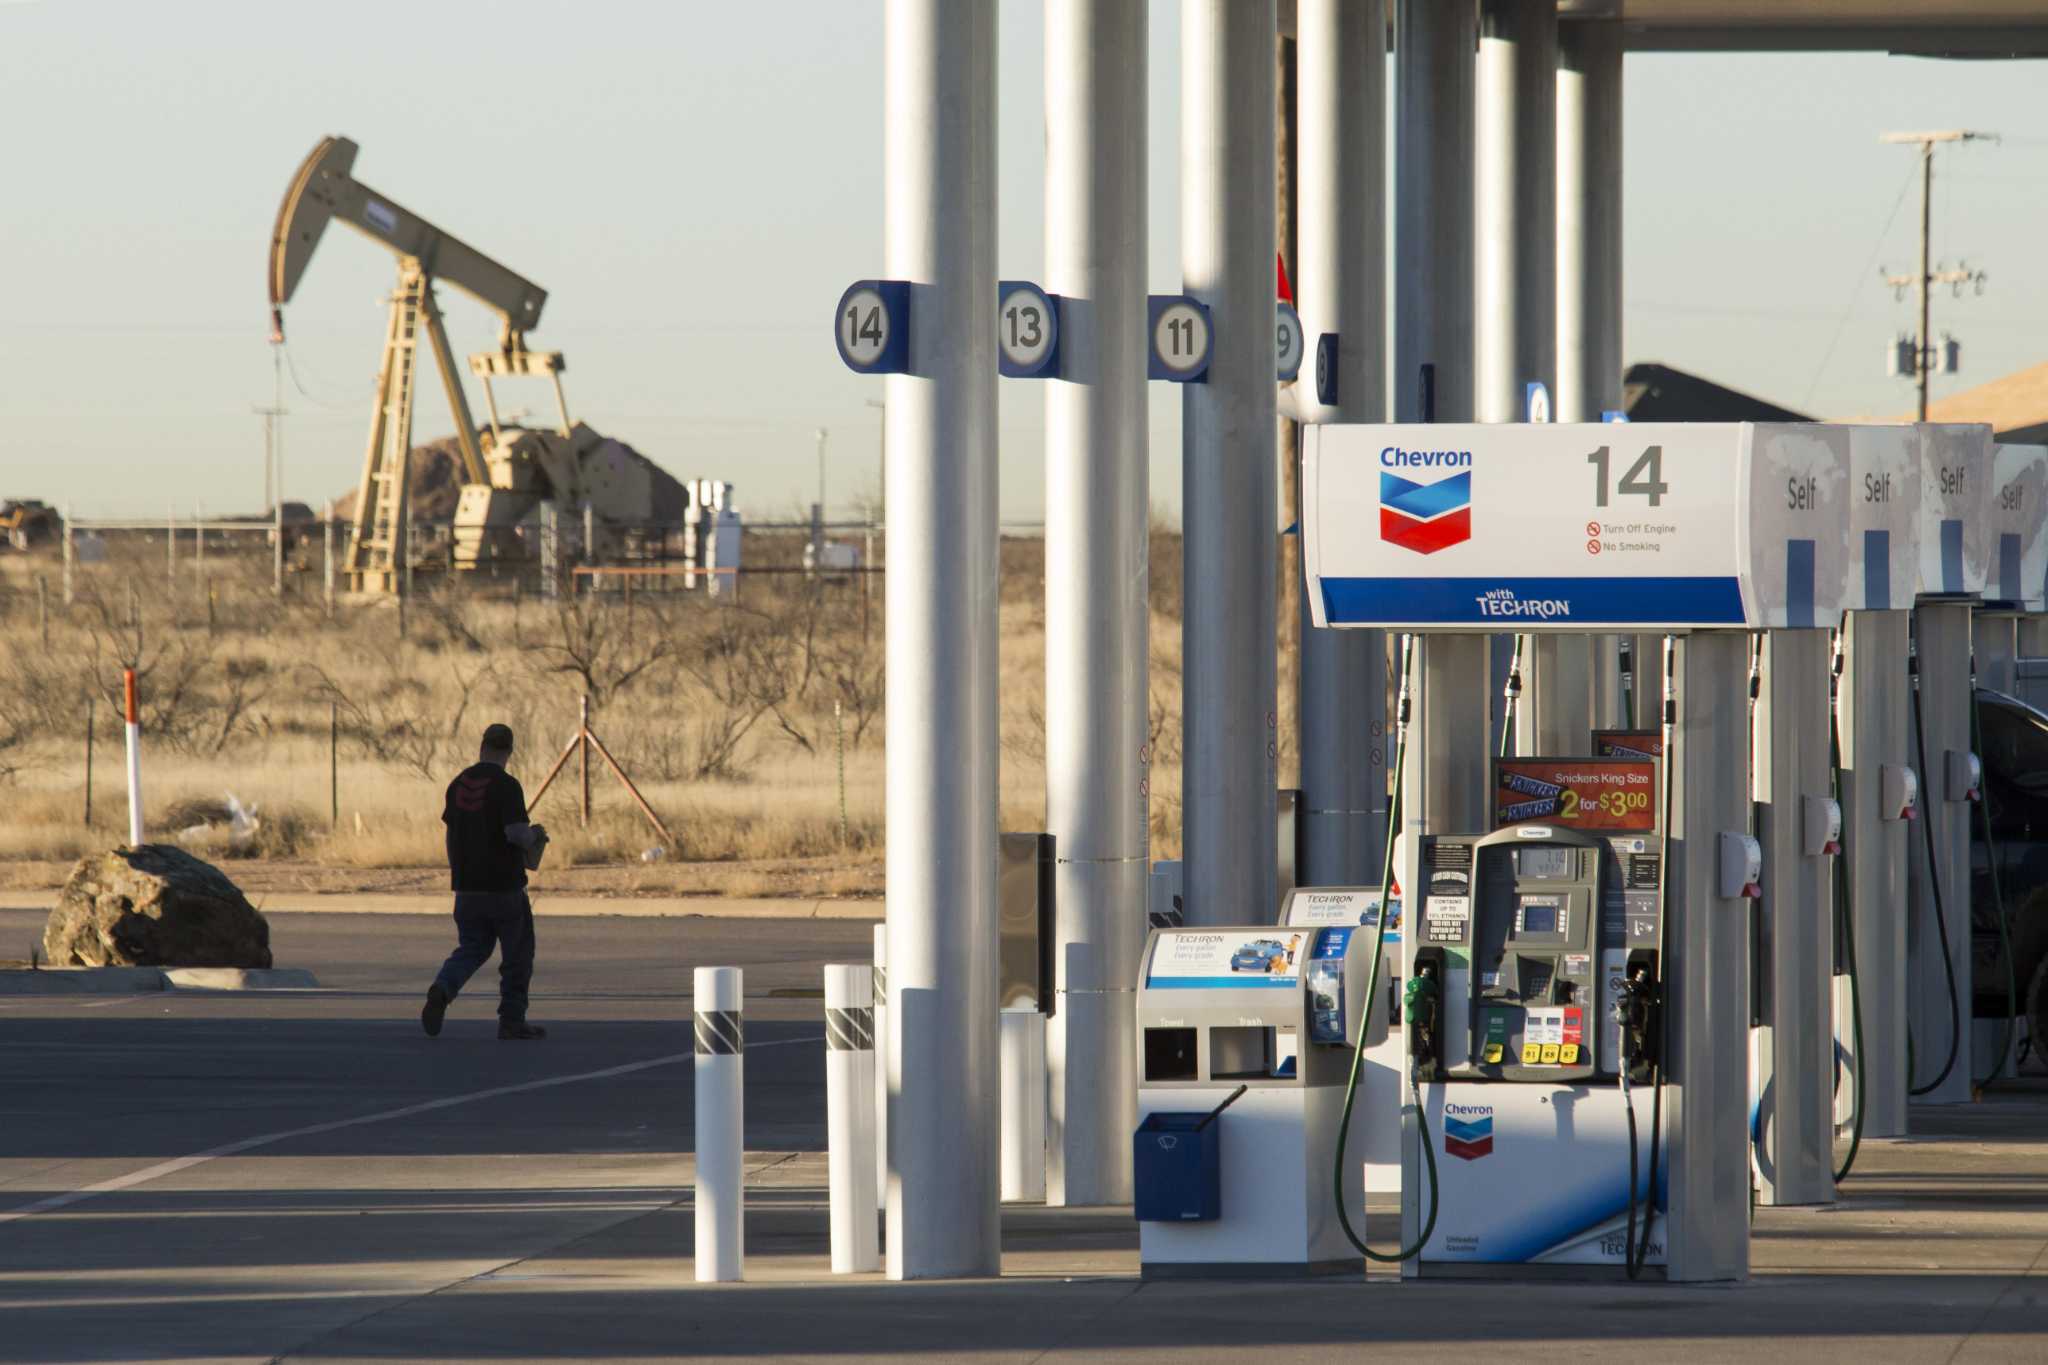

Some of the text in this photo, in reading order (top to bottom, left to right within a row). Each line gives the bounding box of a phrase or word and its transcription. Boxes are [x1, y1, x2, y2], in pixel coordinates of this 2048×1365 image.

[847, 306, 883, 348] 14
[1006, 306, 1042, 348] 13
[1167, 318, 1194, 356] 11
[1277, 323, 1291, 358] 9
[1380, 446, 1472, 467] Chevron
[1587, 445, 1669, 508] 14
[1865, 472, 1891, 503] Self
[1941, 466, 1966, 495] Self
[1787, 476, 1816, 511] Self
[2002, 485, 2023, 511] Self
[1603, 524, 1677, 535] Turn Off Engine
[1603, 542, 1660, 552] No Smoking
[1485, 588, 1514, 600] with
[1475, 597, 1571, 619] TECHRON
[1554, 772, 1649, 786] Snickers King Size
[1560, 789, 1580, 818] 2
[1580, 798, 1598, 811] for
[1308, 895, 1354, 904] TECHRON
[1175, 934, 1224, 945] TECHRON
[1445, 1103, 1493, 1115] Chevron
[1600, 1240, 1663, 1257] TECON
